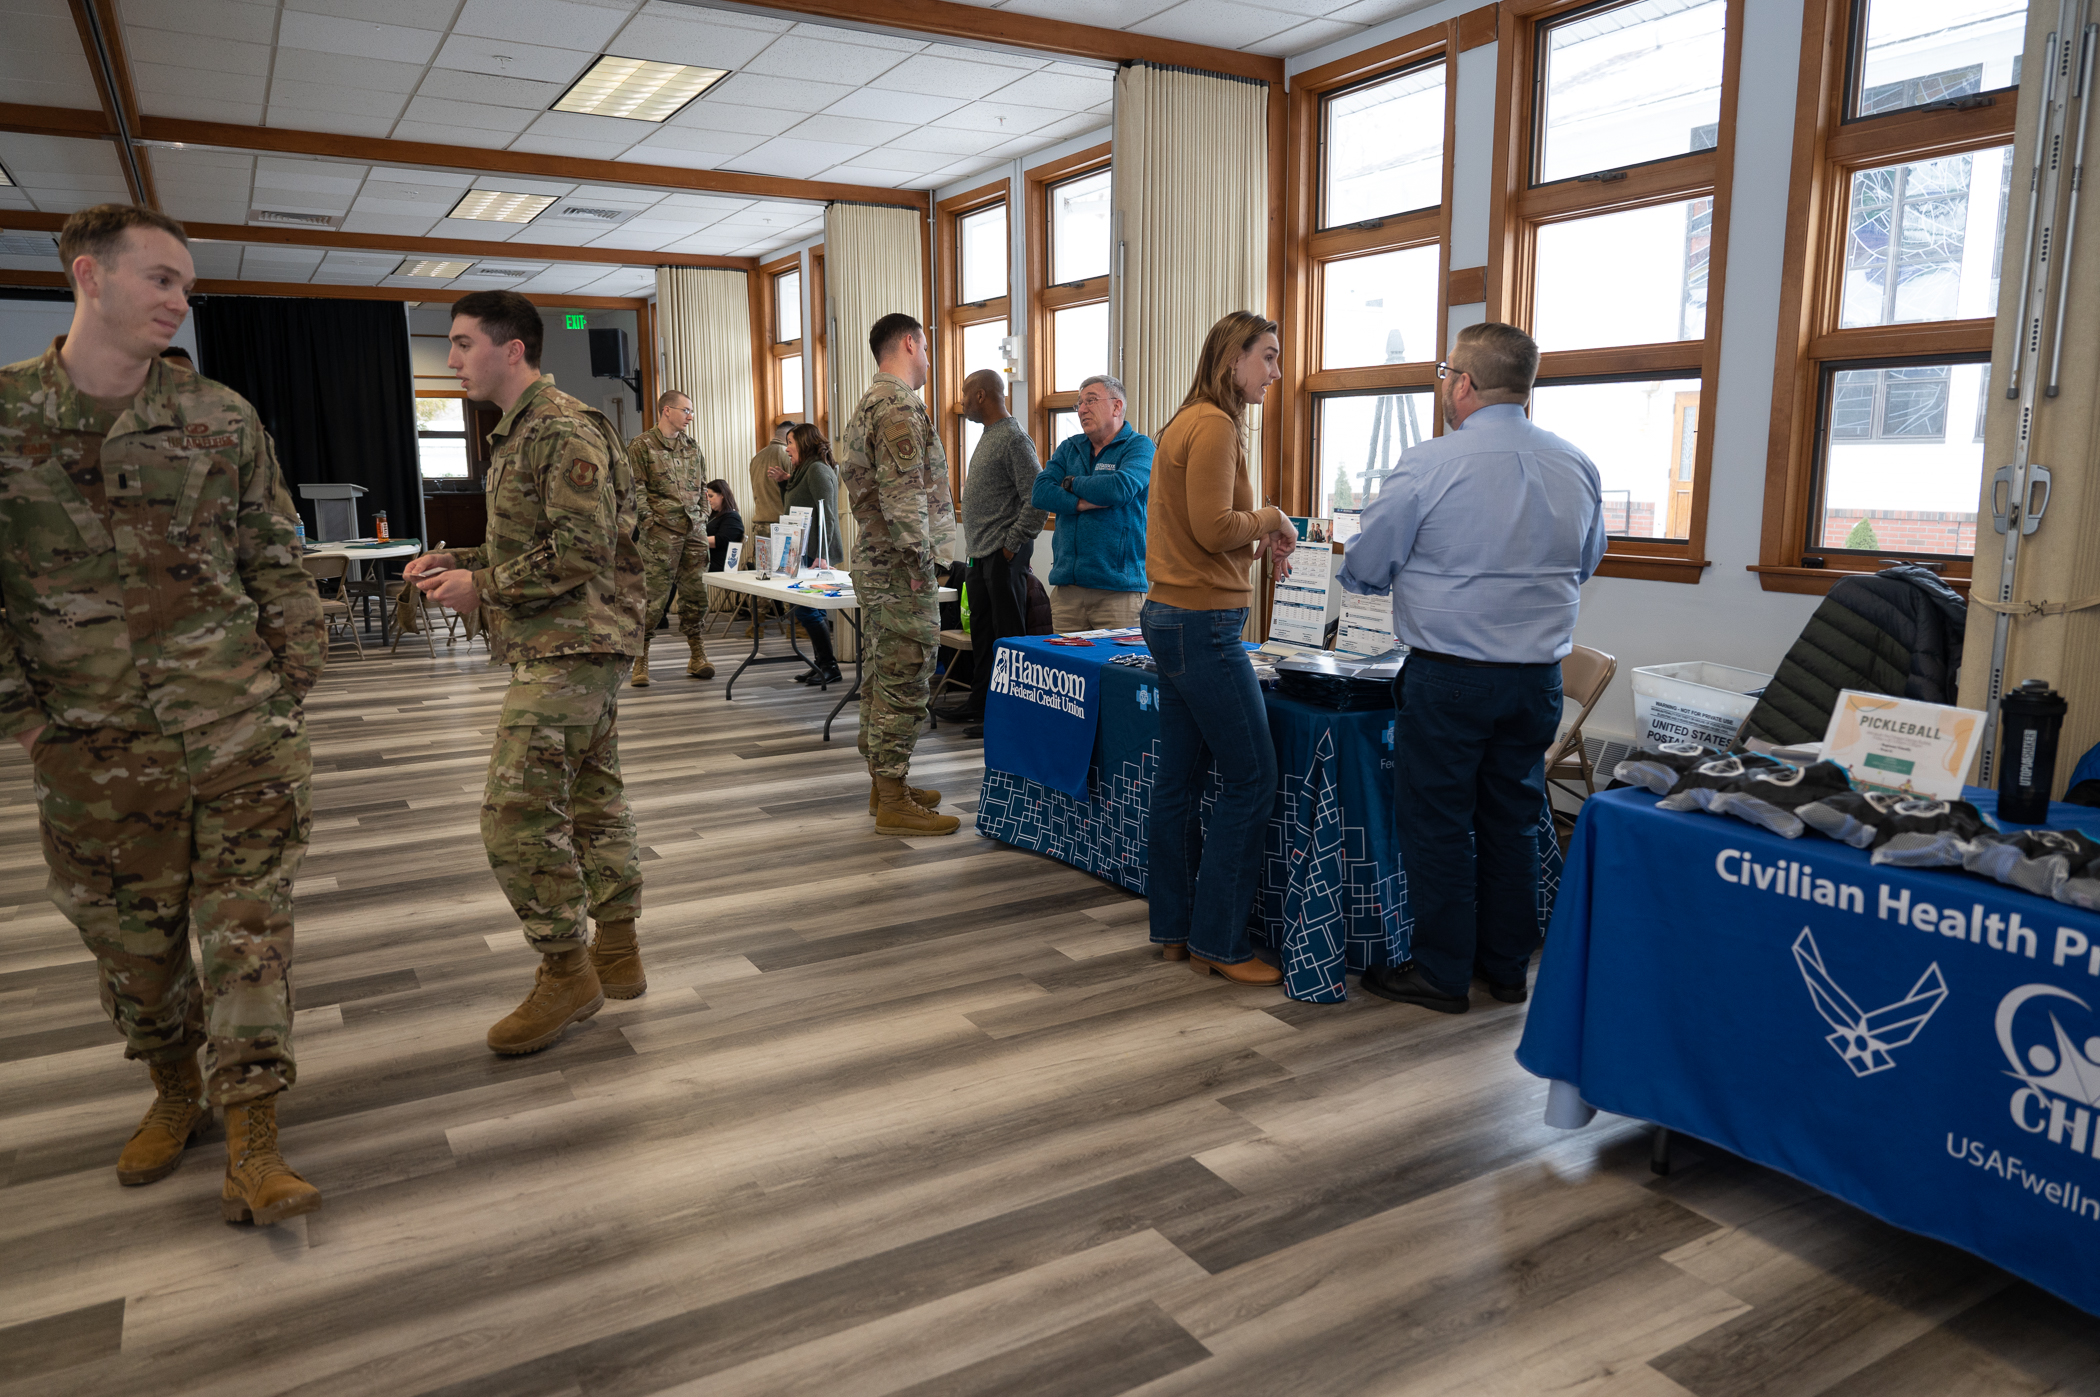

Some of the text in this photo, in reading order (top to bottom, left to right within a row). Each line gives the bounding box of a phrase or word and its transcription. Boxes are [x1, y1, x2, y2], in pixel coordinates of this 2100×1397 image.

[565, 314, 584, 330] EXIT
[1010, 649, 1086, 702] Hanscom
[1009, 681, 1085, 719] Federal Credit Union
[1655, 701, 1677, 711] WARNING
[1702, 712, 1722, 722] PRIVATE
[1652, 719, 1689, 736] UNITED
[1690, 729, 1732, 748] STATES
[1859, 715, 1942, 740] PICKLEBALL
[1715, 848, 1865, 915] Civilian
[1877, 883, 2038, 960] Health
[1946, 1132, 2100, 1221] USAFwelln
